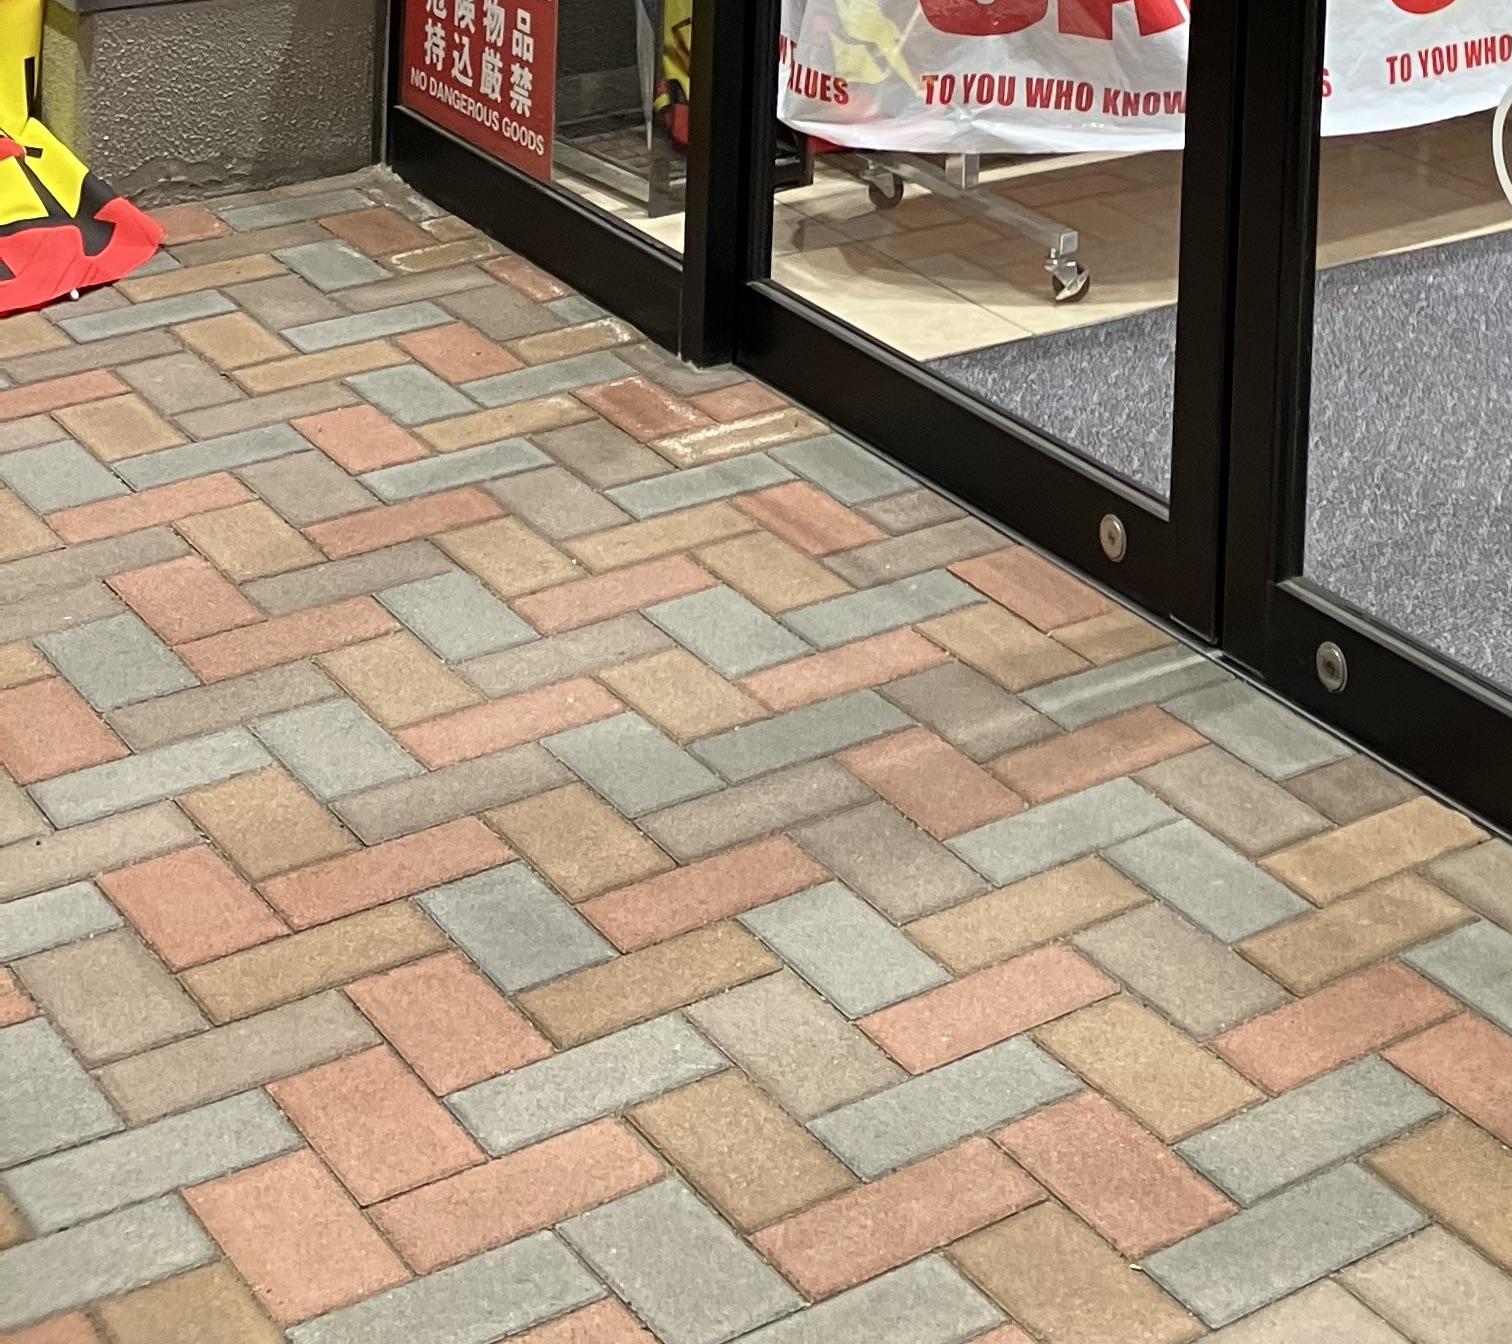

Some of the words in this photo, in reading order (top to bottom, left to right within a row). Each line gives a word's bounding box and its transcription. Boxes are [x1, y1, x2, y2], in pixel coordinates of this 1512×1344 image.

[424, 18, 533, 118] 持込厳禁
[922, 74, 955, 106] TO
[963, 72, 1016, 107] YOU
[1026, 75, 1094, 112] WHO
[1102, 87, 1187, 117] KNOW
[1386, 52, 1413, 85] TO
[1418, 43, 1458, 78] YOU
[1464, 33, 1512, 69] WHO
[410, 67, 427, 92] NO
[428, 76, 500, 133] DANGEROUS
[502, 116, 546, 157] GOODS
